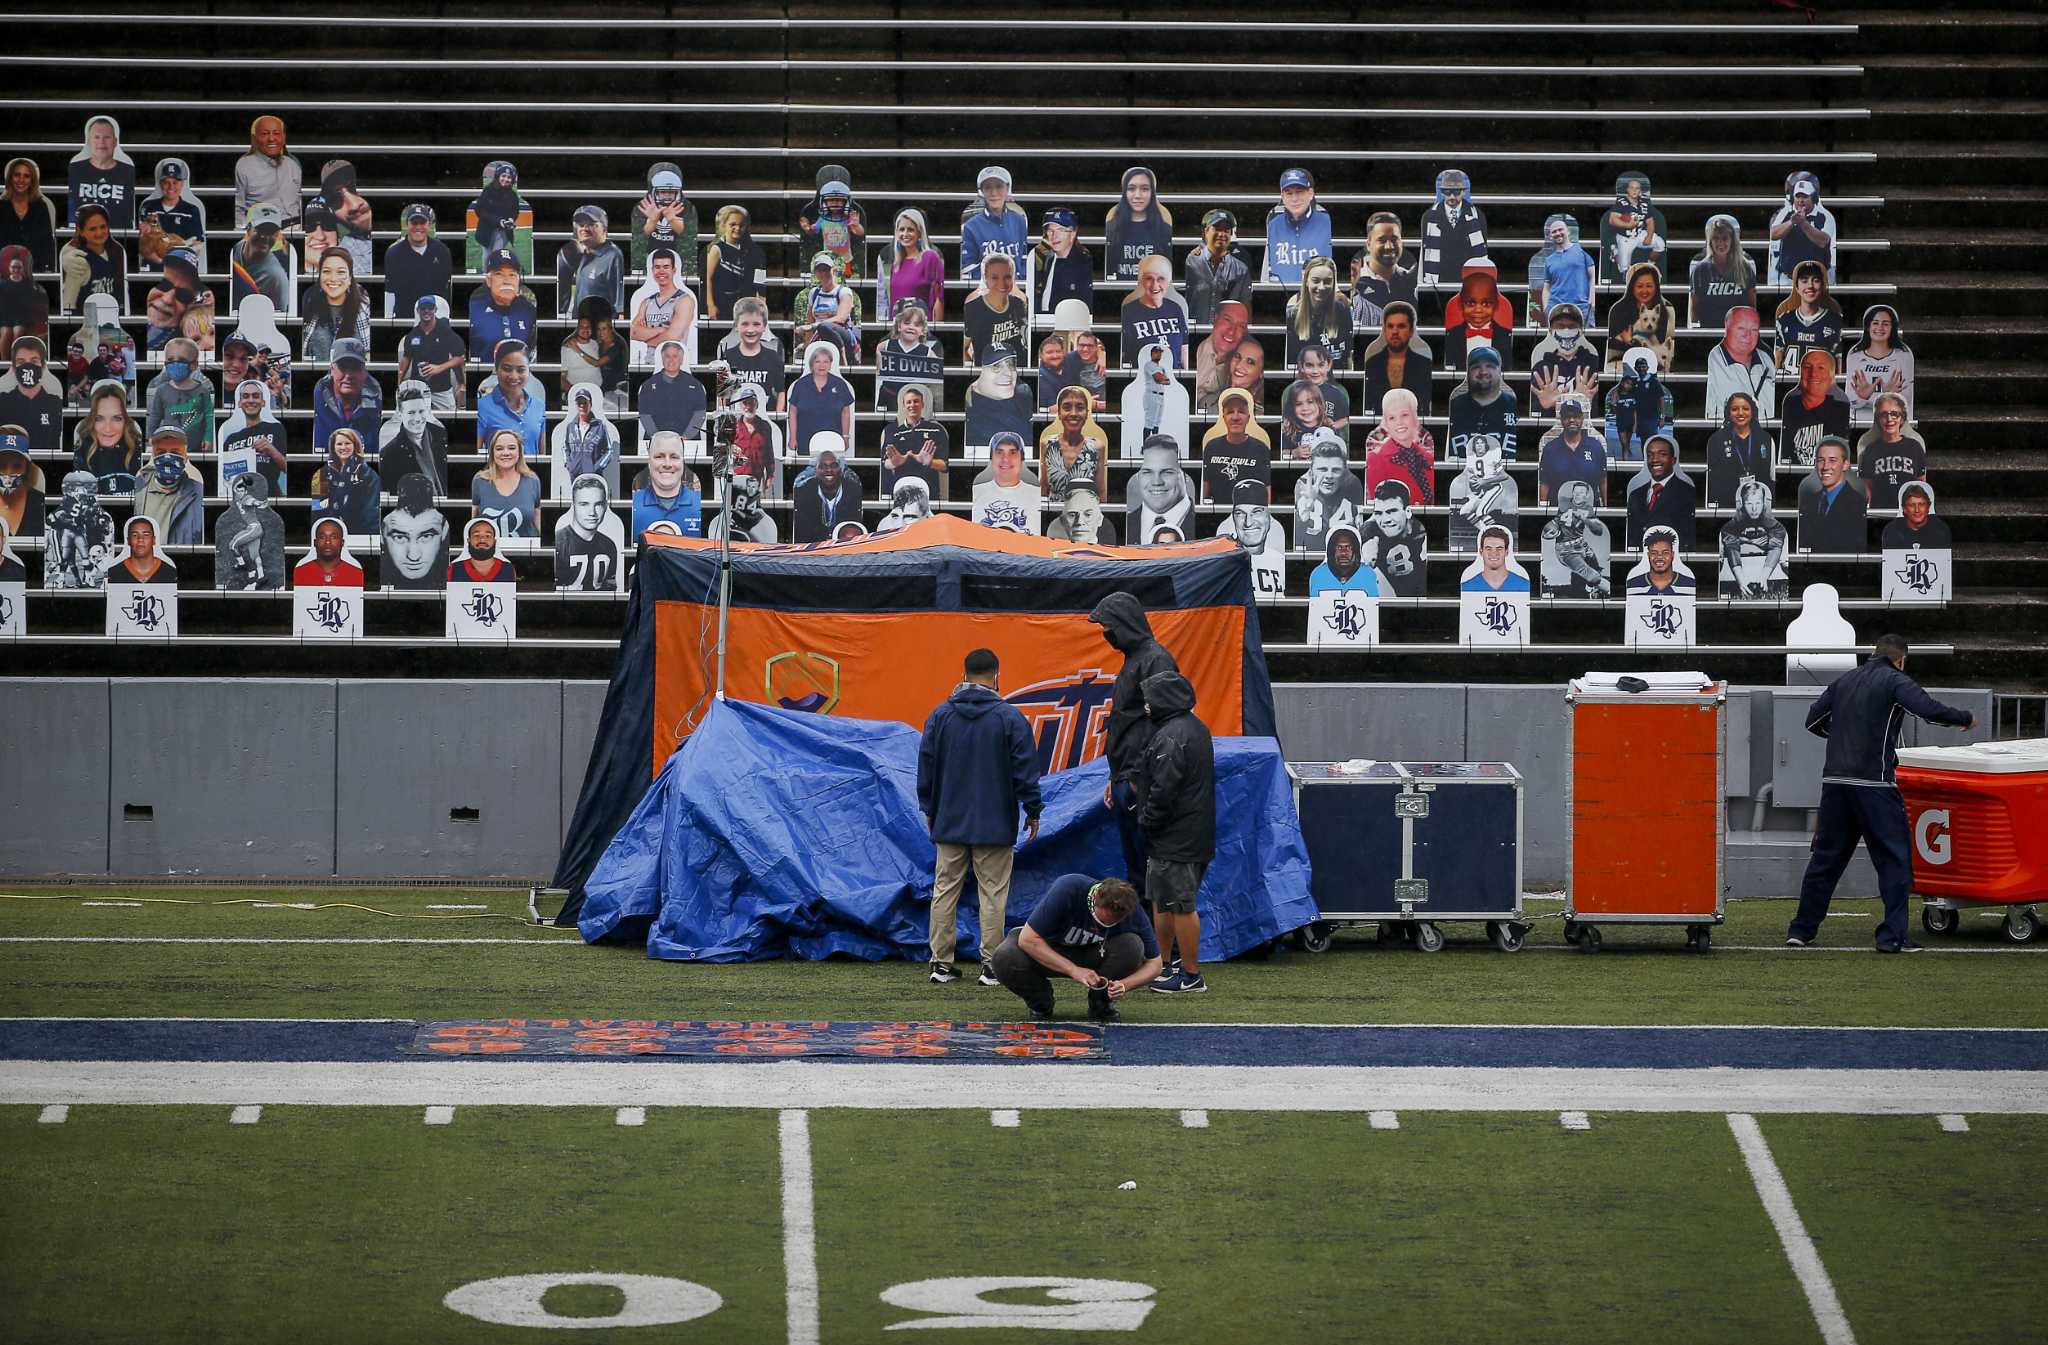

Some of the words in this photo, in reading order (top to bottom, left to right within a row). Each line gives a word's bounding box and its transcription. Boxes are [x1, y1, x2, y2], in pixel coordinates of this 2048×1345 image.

[79, 183, 124, 200] RICE
[1123, 246, 1152, 260] RICE
[1707, 281, 1743, 296] RICE
[991, 326, 1020, 343] OWLS
[994, 319, 1018, 334] RICE
[1133, 317, 1182, 341] RICE
[1797, 331, 1815, 342] RICE
[1864, 364, 1890, 374] RICE
[1451, 433, 1517, 455] RE
[1210, 455, 1230, 466] RICE
[1230, 456, 1257, 467] OWLS
[1874, 455, 1914, 475] RICE
[570, 554, 611, 591] 70
[1252, 567, 1283, 594] CE
[1915, 809, 1952, 865] G
